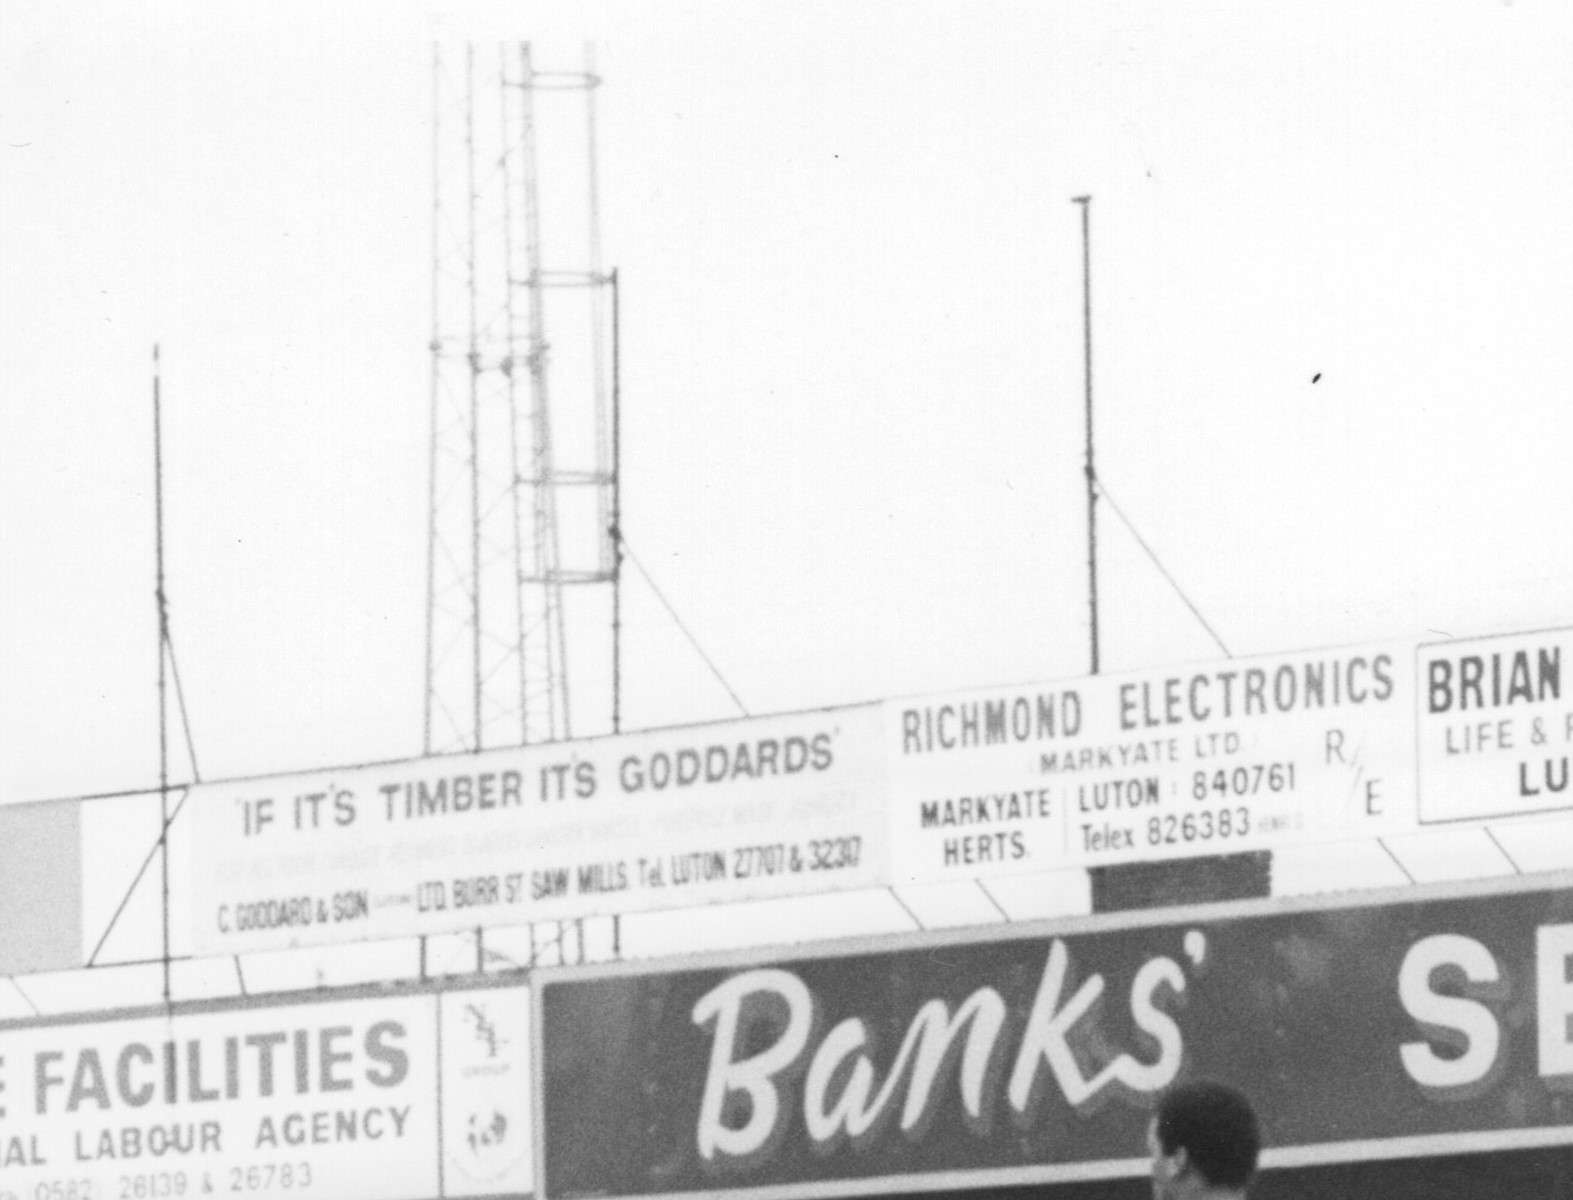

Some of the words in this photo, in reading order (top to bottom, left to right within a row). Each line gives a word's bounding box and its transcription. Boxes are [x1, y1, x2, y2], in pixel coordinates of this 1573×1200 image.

[902, 690, 1082, 754] RICHMOND
[1119, 654, 1395, 731] ELECTRONICS
[1428, 645, 1561, 714] BRIAN
[1040, 738, 1180, 774] MARKYATE
[1445, 719, 1514, 756] LIFE
[1530, 715, 1547, 745] &
[379, 770, 522, 821] TIMBER
[920, 788, 1051, 829] MARKYATE
[1078, 776, 1160, 813] LUTON
[1192, 762, 1296, 800] 840761
[1082, 822, 1135, 853] Telex
[1148, 807, 1250, 846] 826383
[333, 889, 369, 923] SON
[672, 849, 726, 886] LUTON
[34, 1020, 409, 1115] FACILITIES
[75, 1121, 222, 1162] LABOUR
[255, 1106, 411, 1149] AGENCY
[119, 1170, 188, 1200] 26139
[229, 1161, 314, 1192] 26783
